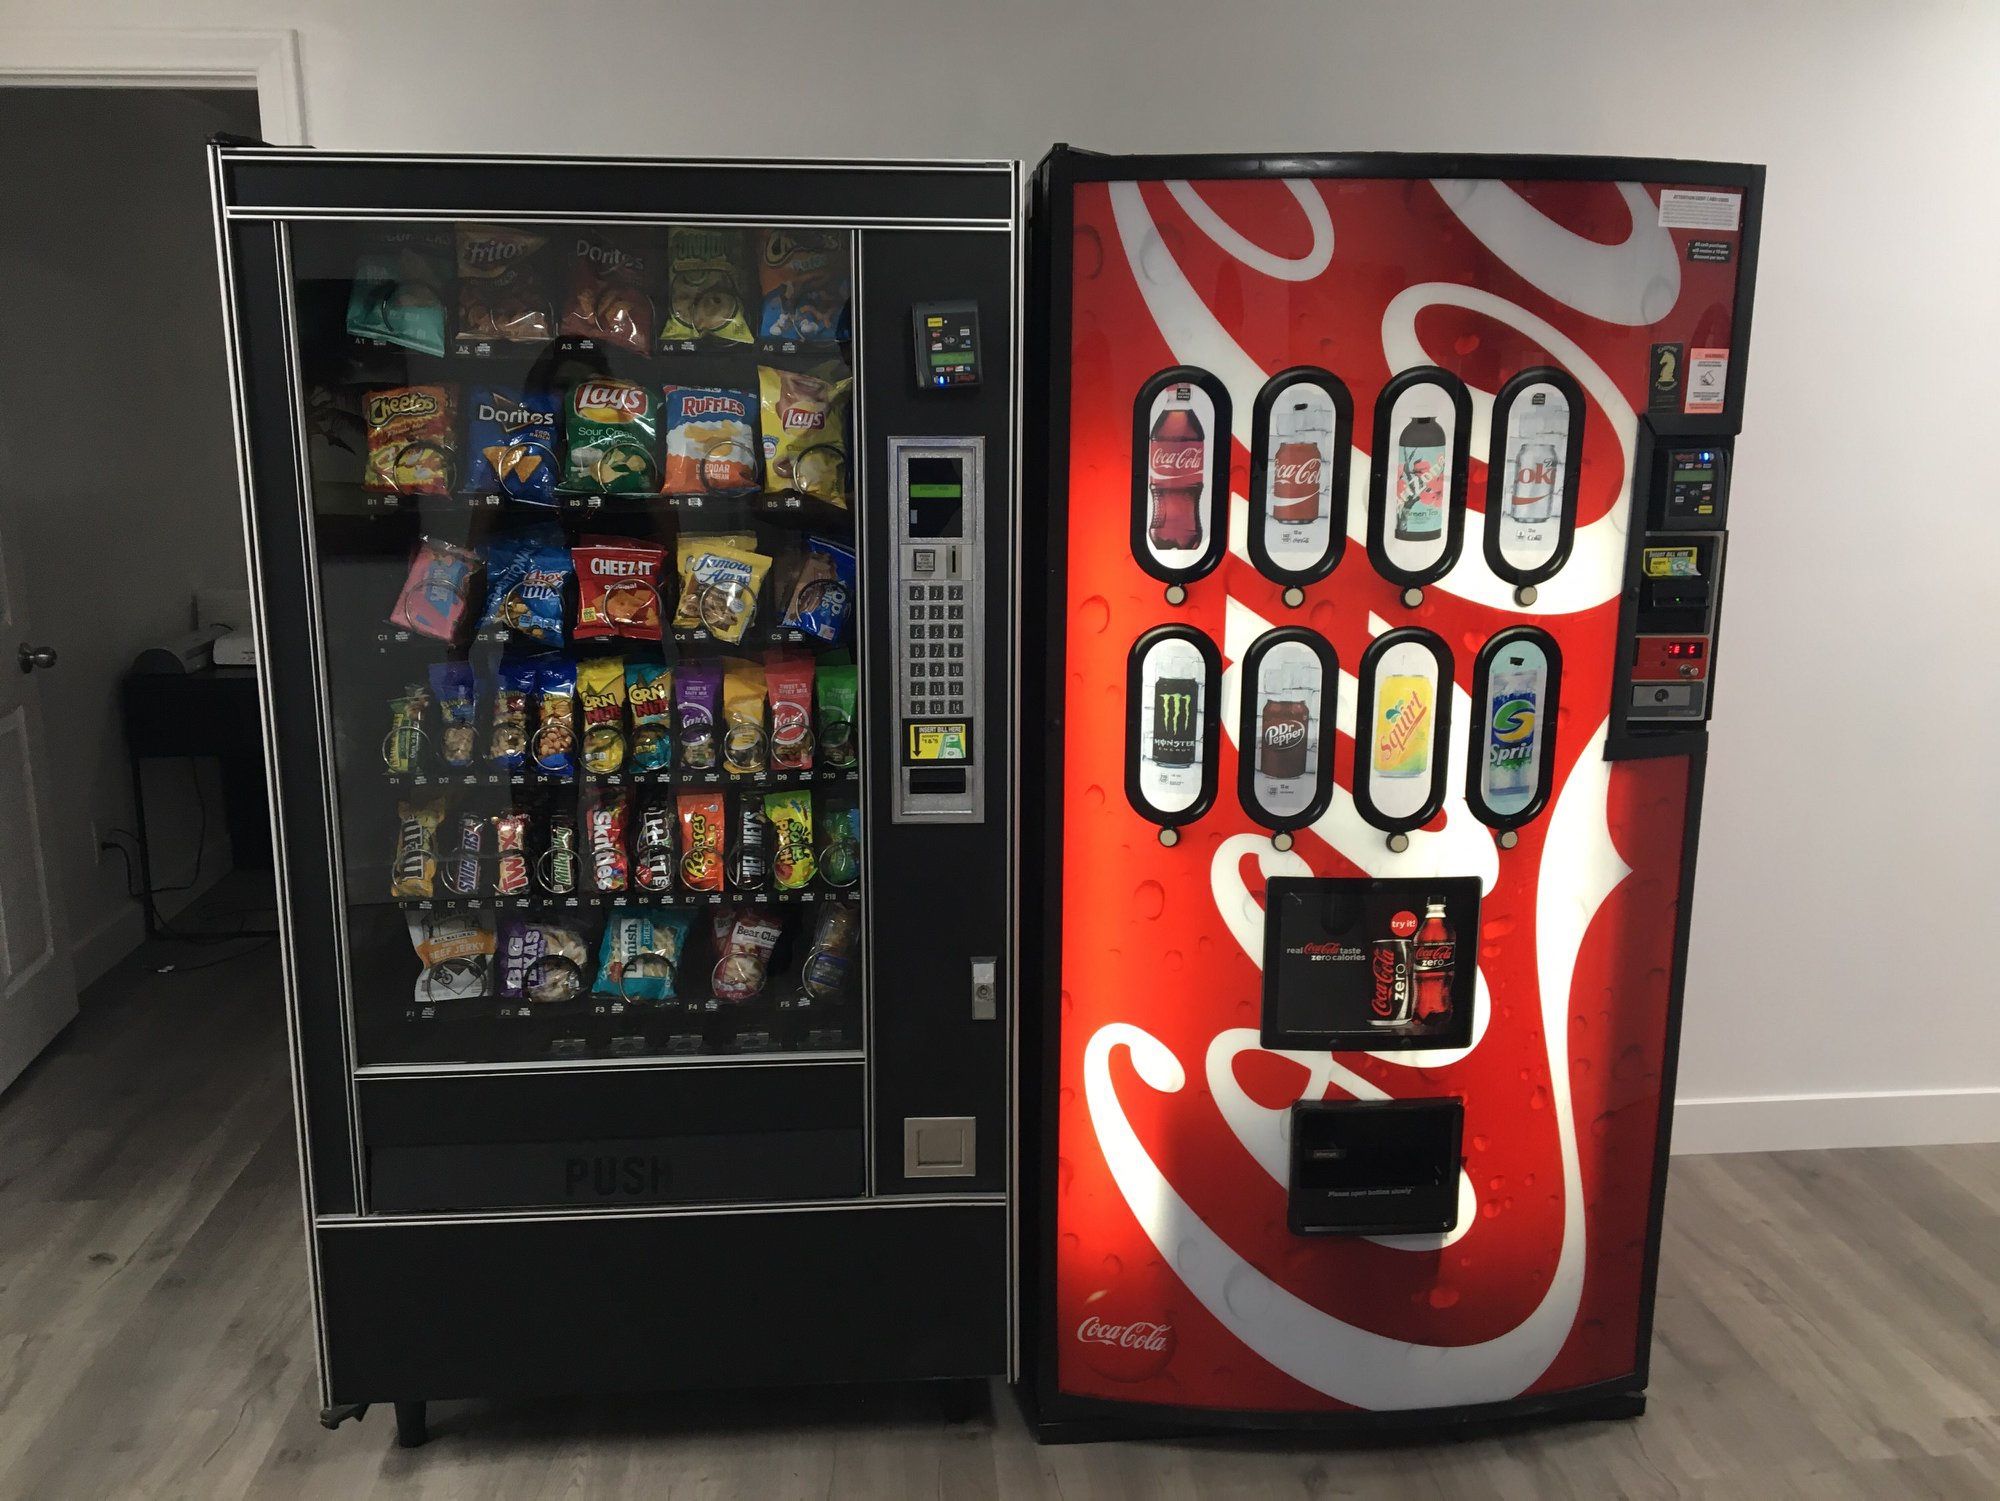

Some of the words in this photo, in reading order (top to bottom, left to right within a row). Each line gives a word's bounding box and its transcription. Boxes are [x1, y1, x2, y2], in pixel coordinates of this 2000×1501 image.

[576, 239, 644, 270] Doritos
[578, 385, 643, 409] Lay's
[682, 396, 745, 416] RUFFLES
[368, 392, 437, 427] Cheetos
[479, 405, 553, 425] Doritos
[785, 409, 823, 429] Lay's
[578, 427, 603, 436] Sour
[696, 464, 730, 473] CEDDAR
[1152, 447, 1202, 470] Coca-Cola
[692, 553, 753, 573] Famous
[581, 691, 617, 712] CORN
[629, 684, 666, 706] CORN
[1266, 725, 1304, 747] Pepper
[1279, 723, 1295, 736] Dr
[1380, 690, 1424, 761] Squirt
[1154, 739, 1195, 749] MONSTER
[1490, 743, 1534, 766] Sprit
[500, 831, 529, 891] TWX
[593, 811, 614, 890] Skittles
[737, 926, 760, 937] Bear
[1391, 920, 1405, 929] try
[1406, 919, 1417, 927] it!
[454, 942, 485, 954] JERKY
[1303, 942, 1340, 954] Coca-Cola
[1332, 954, 1366, 962] calories
[1415, 946, 1452, 960] Coca-Cola
[1372, 948, 1395, 1017] Coca-Cola
[1395, 963, 1406, 1001] zero
[566, 1156, 673, 1197] PUSH
[1077, 1316, 1171, 1351] Coca-Cola
